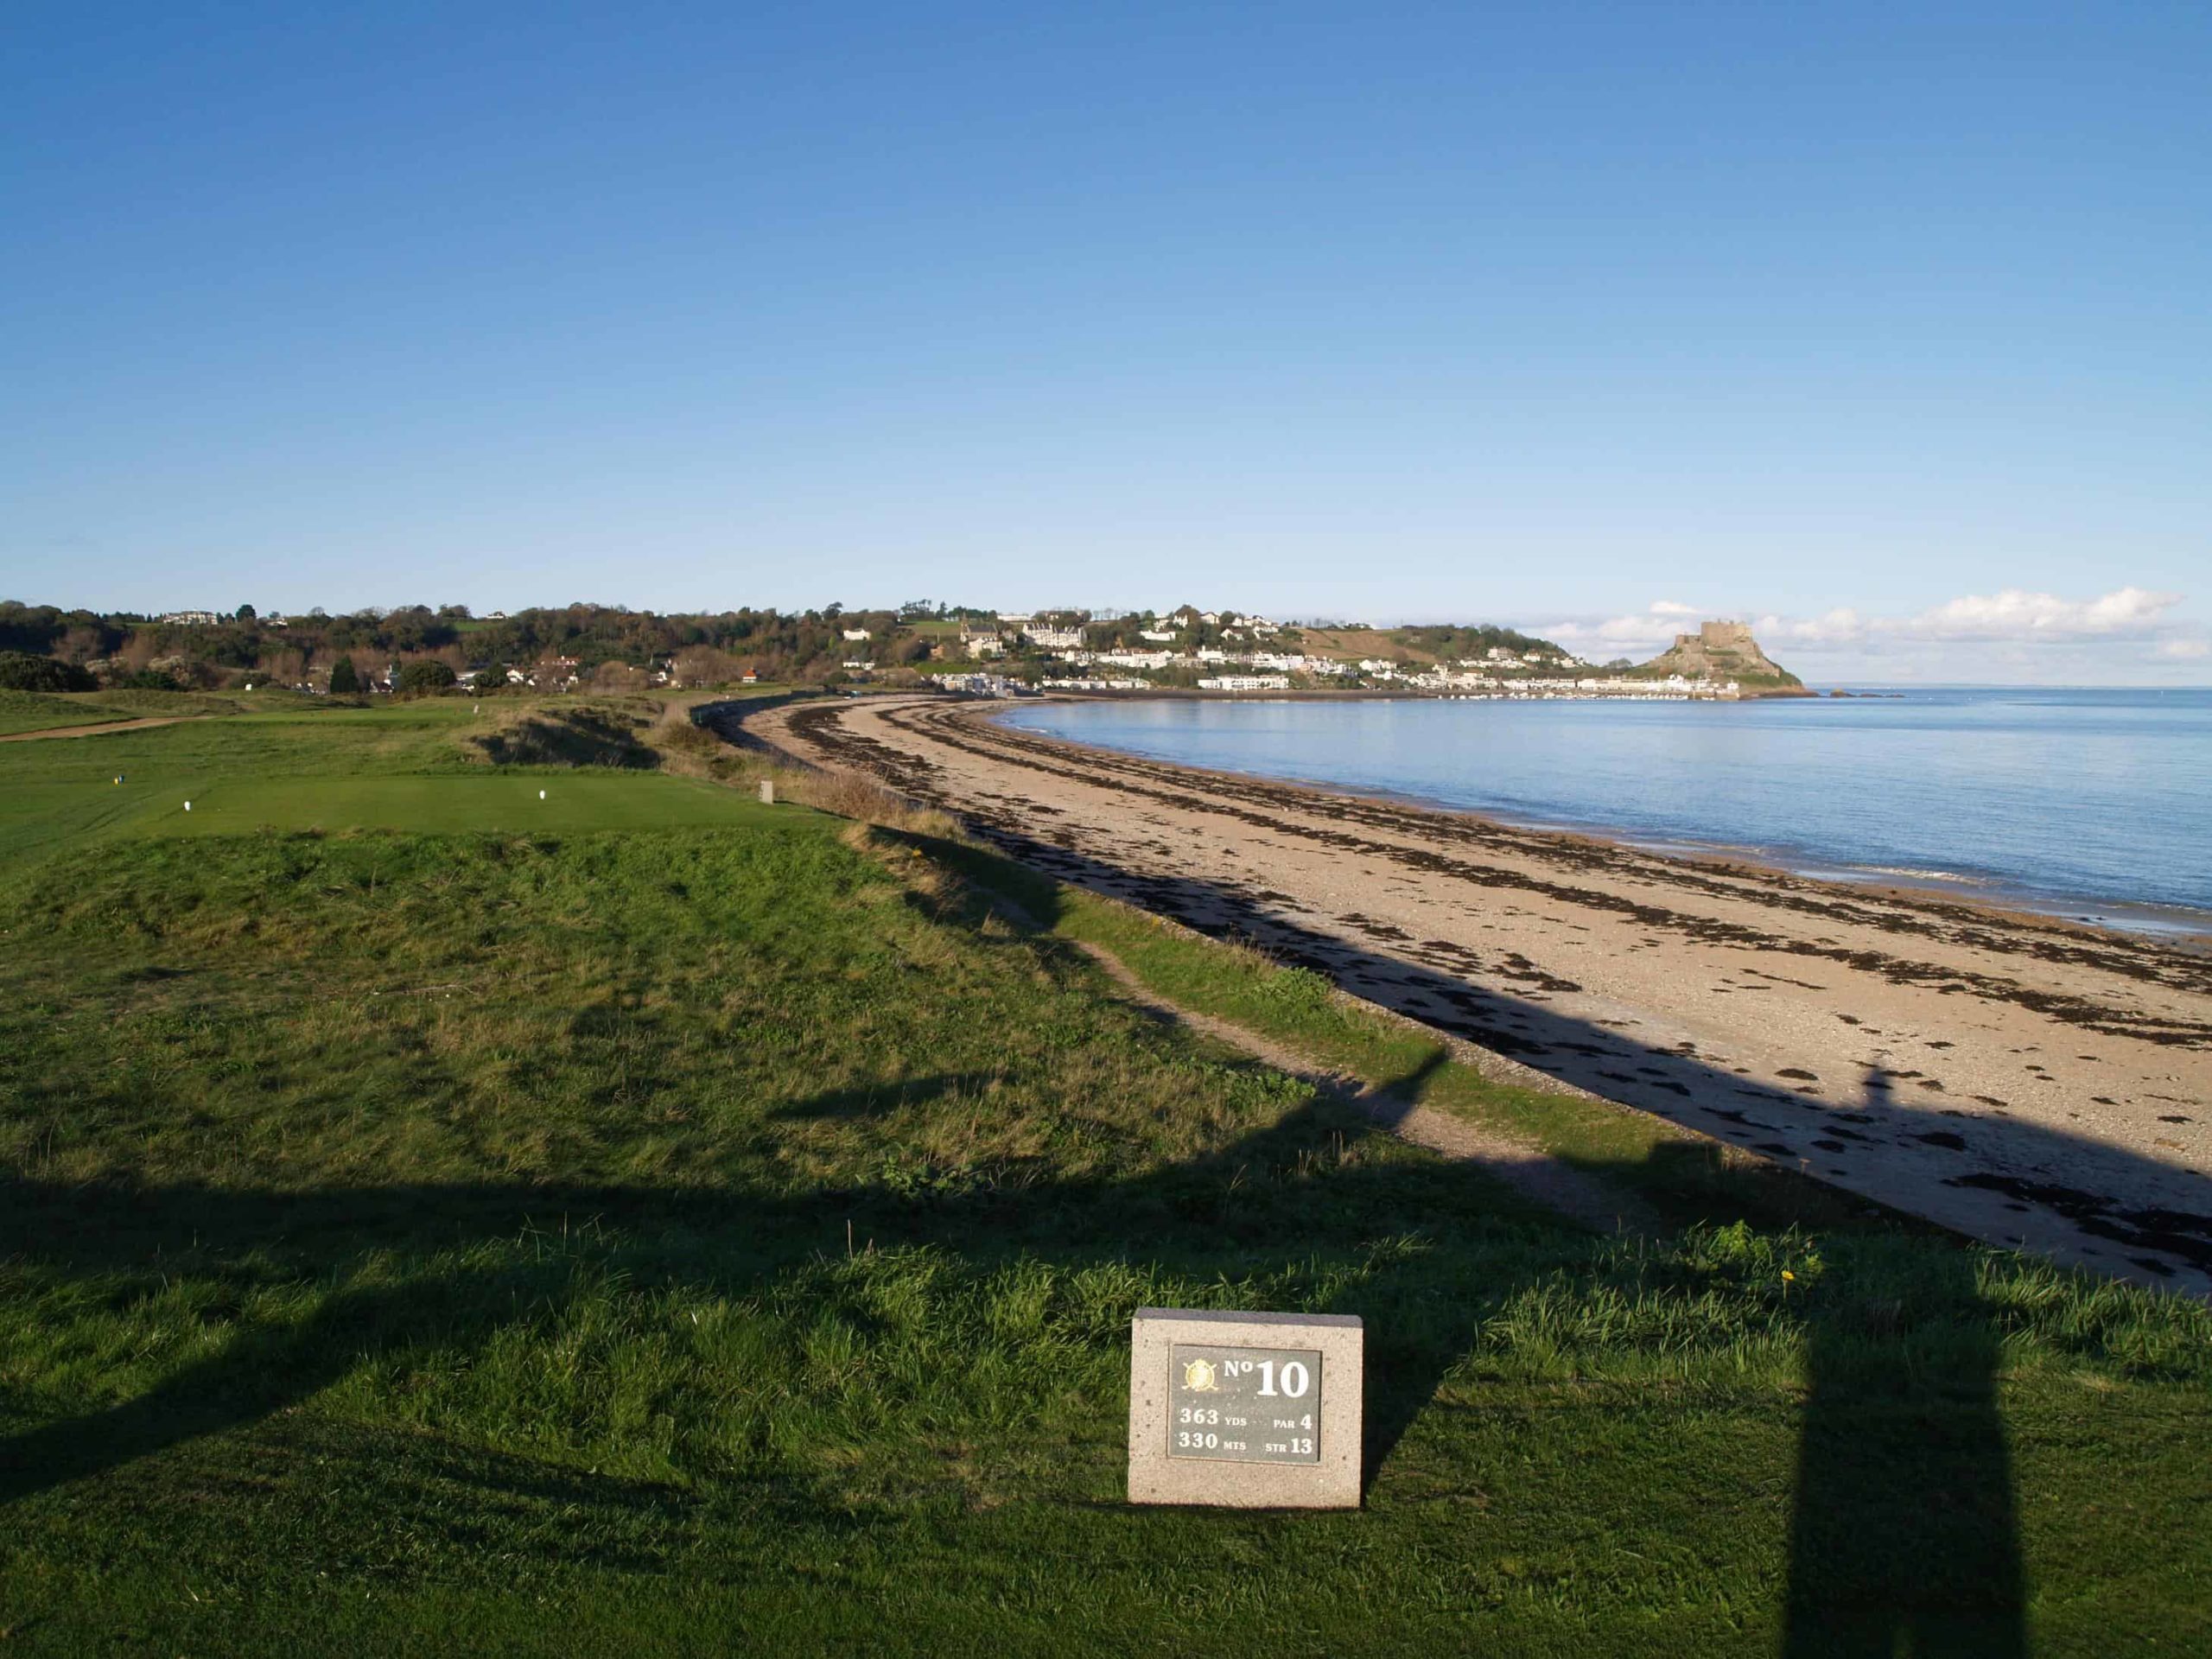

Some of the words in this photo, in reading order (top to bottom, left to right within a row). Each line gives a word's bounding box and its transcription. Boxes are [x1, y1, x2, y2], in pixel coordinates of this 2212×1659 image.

[1256, 1360, 1309, 1398] 10
[1179, 1408, 1218, 1425] 363
[1224, 1417, 1247, 1427] YDS
[1274, 1420, 1295, 1428] PAR
[1300, 1414, 1313, 1429] 4
[1179, 1432, 1217, 1449] 330
[1224, 1441, 1247, 1451] MTS
[1265, 1443, 1287, 1452] STR
[1291, 1438, 1313, 1454] 13
